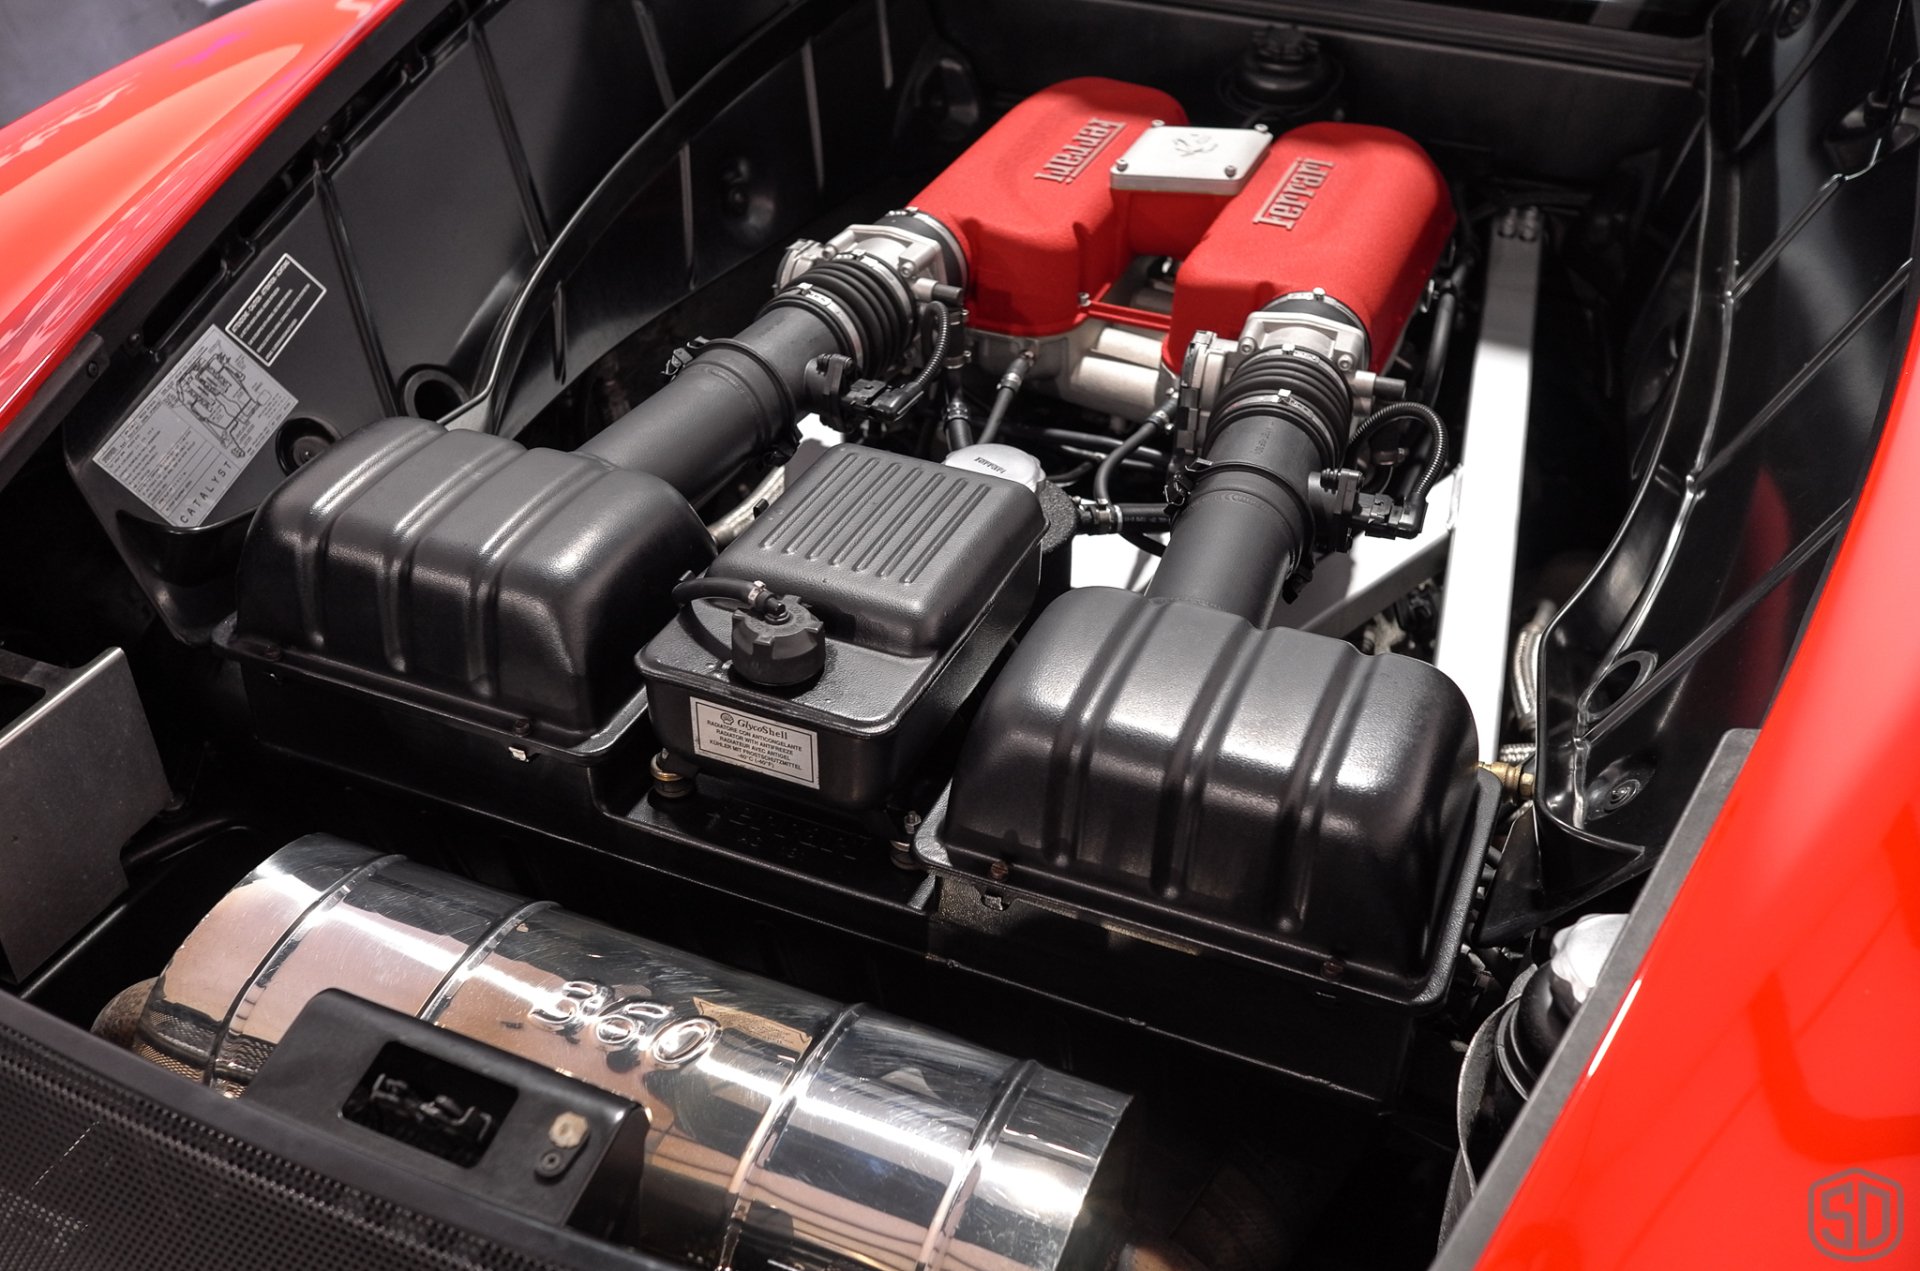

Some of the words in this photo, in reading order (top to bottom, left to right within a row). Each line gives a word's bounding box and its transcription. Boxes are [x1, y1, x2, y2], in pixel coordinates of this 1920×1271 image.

[1034, 117, 1126, 184] Ferrari
[1253, 156, 1336, 231] Ferrari
[974, 457, 1006, 474] Ferrari
[179, 460, 234, 524] CATALYST
[707, 720, 737, 733] RADIATORE
[739, 728, 751, 737] CON
[752, 733, 803, 751] ANTICONGELANTE
[716, 729, 744, 742] RADIATOR
[745, 736, 759, 745] WITH
[760, 741, 794, 755] ANTIFREEZE
[737, 719, 788, 740] GlycoShell
[720, 736, 750, 749] RADIATEUR
[751, 745, 766, 754] AVEC
[767, 749, 791, 760] ANTIGEL
[743, 749, 802, 770] FROSTSCHUTZMITTEL
[528, 979, 722, 1065] 360
